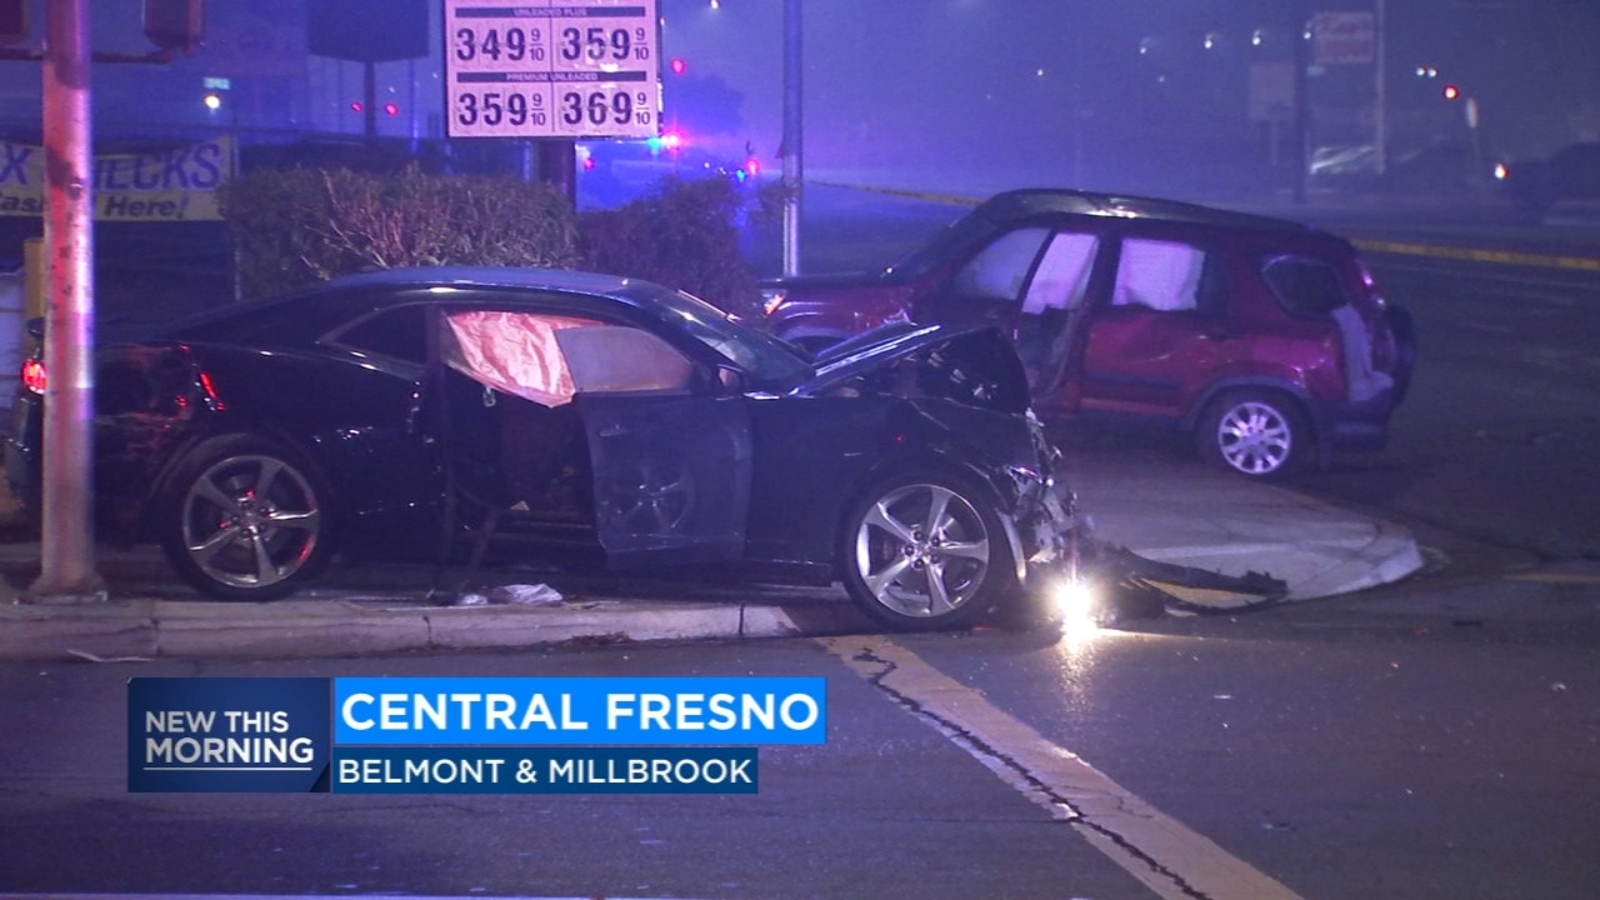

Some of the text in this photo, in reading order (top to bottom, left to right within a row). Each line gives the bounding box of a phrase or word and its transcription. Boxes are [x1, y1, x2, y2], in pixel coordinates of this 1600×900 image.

[512, 7, 562, 17] UNLEADED
[456, 27, 526, 61] 349
[562, 27, 631, 61] 359
[551, 72, 598, 81] UNLEADED
[458, 93, 528, 126] 359
[563, 91, 632, 125] 369
[93, 142, 221, 190] ECKS
[104, 195, 190, 219] Here!
